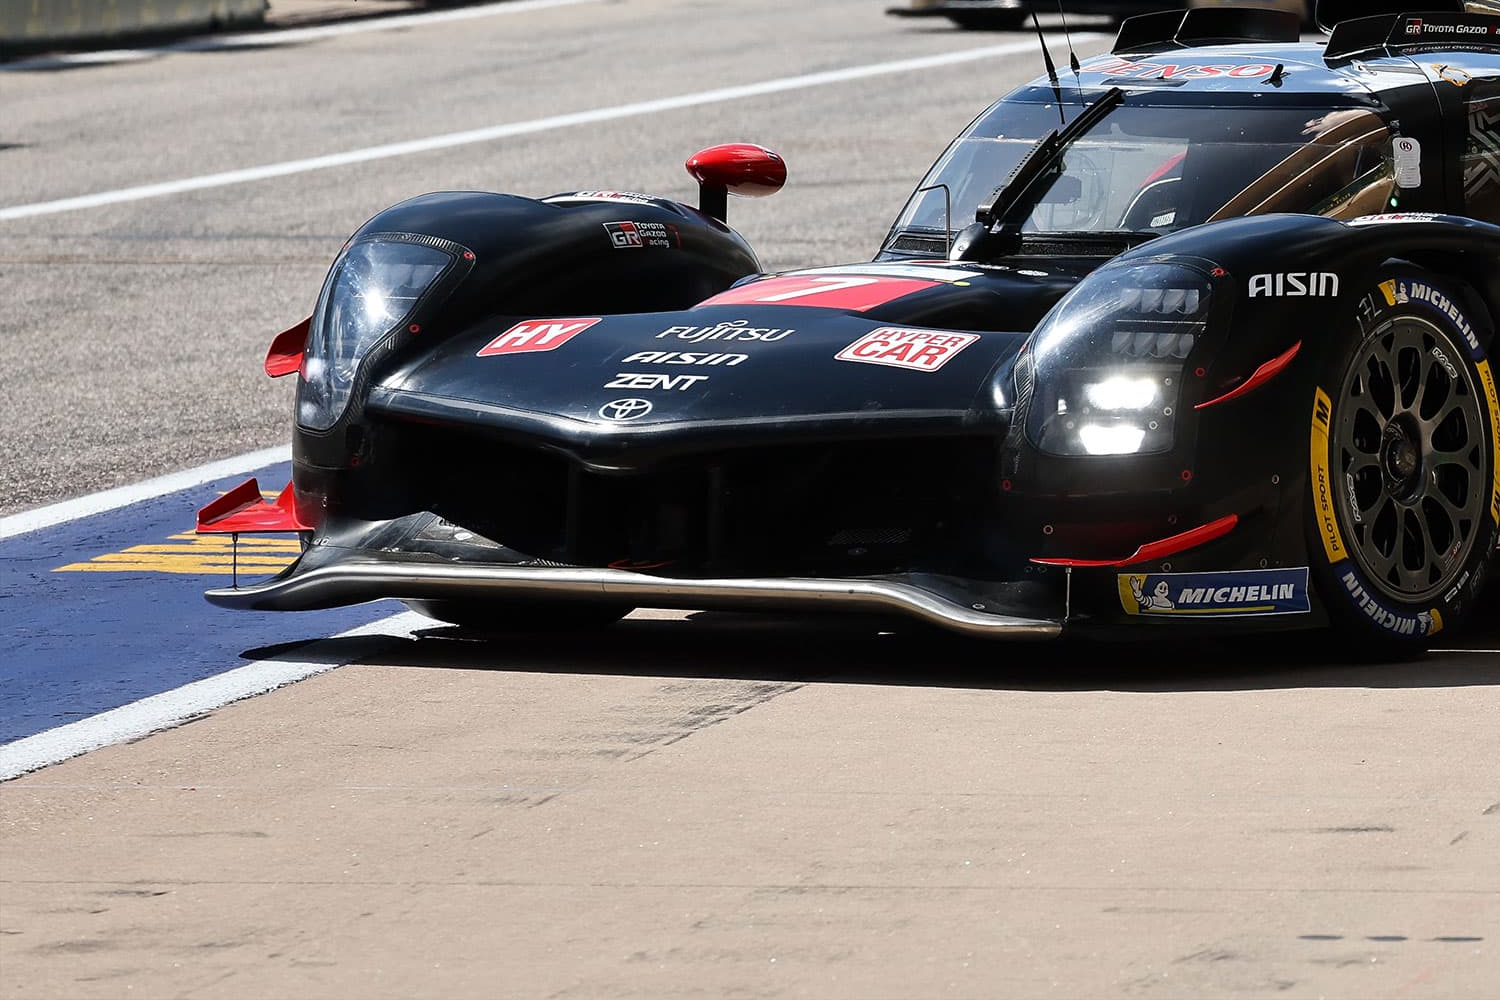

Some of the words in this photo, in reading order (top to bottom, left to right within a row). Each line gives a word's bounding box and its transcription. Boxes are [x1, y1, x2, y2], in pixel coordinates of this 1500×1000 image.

[1405, 23, 1421, 36] GR
[1423, 24, 1455, 34] TOYOTA
[1456, 24, 1488, 35] GAZOO
[1081, 60, 1276, 80] DENSO
[612, 231, 641, 246] GR
[635, 222, 665, 231] TOYOTA
[755, 278, 878, 302] 7
[1248, 272, 1339, 298] AISIN
[1411, 282, 1480, 350] MICHELIN
[507, 322, 569, 350] HY
[655, 325, 796, 345] FUJITSU
[875, 328, 967, 348] HYPER
[621, 351, 749, 367] AISIN
[852, 339, 950, 368] CAR
[604, 373, 709, 391] ZENT
[1484, 369, 1497, 405] PILOT
[1315, 399, 1330, 427] M
[1317, 465, 1329, 510] SPORT
[1324, 513, 1339, 552] PILOT
[1179, 581, 1295, 604] MICHELIN
[1341, 571, 1417, 635] MICHELIN
